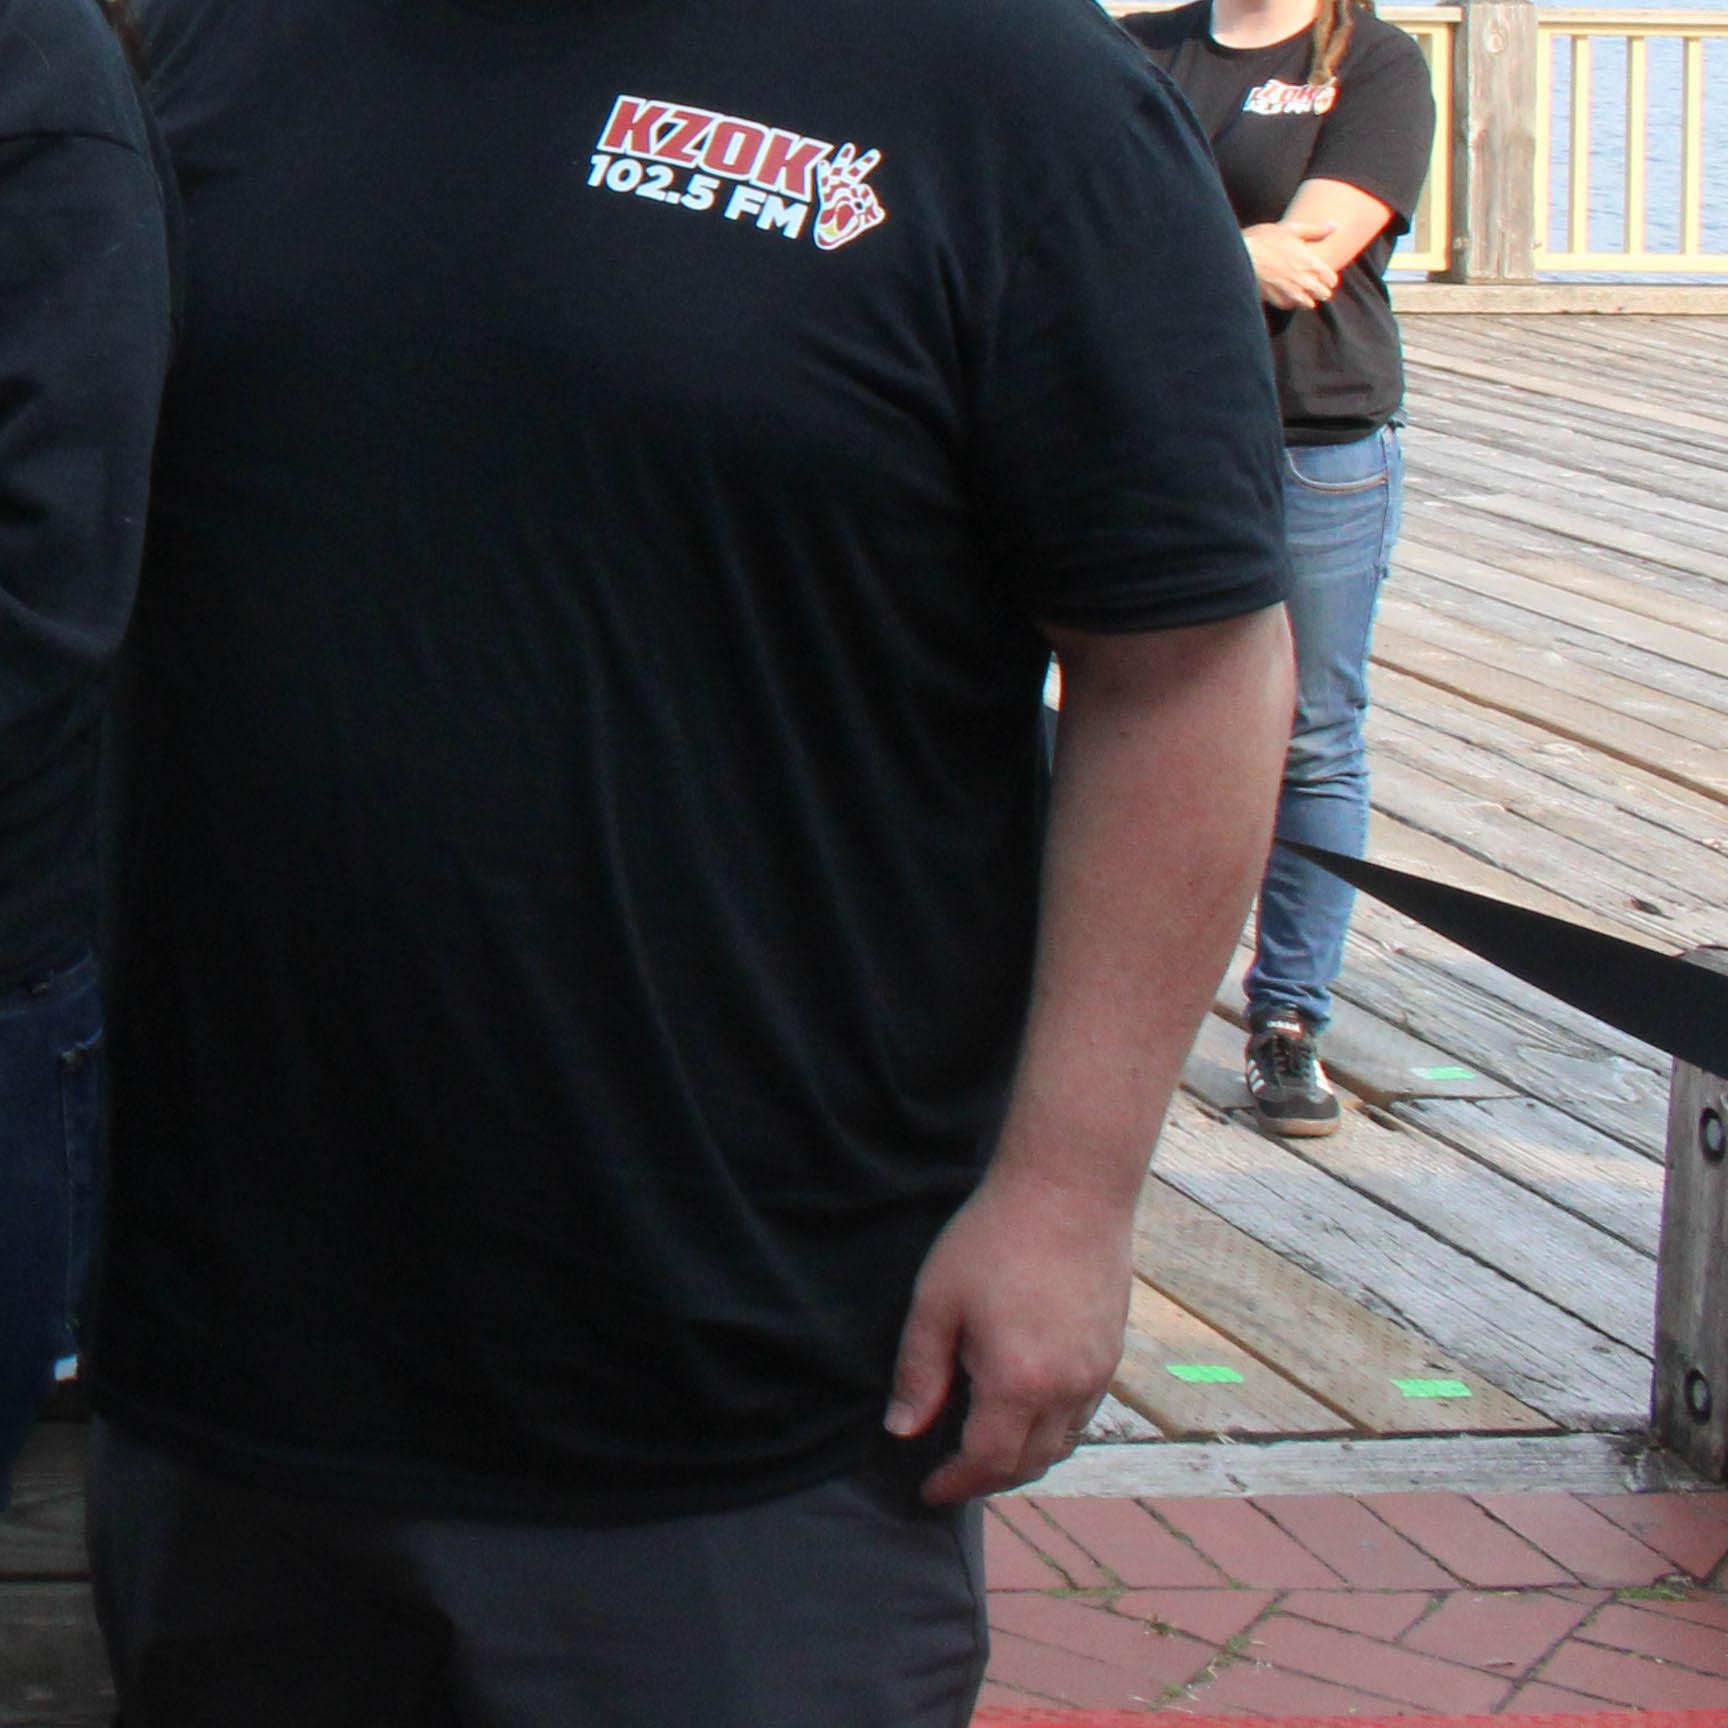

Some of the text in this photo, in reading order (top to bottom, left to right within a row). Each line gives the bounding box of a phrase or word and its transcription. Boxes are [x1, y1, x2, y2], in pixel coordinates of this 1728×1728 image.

[587, 154, 809, 240] 102.5 FM
[596, 94, 834, 203] KZOK
